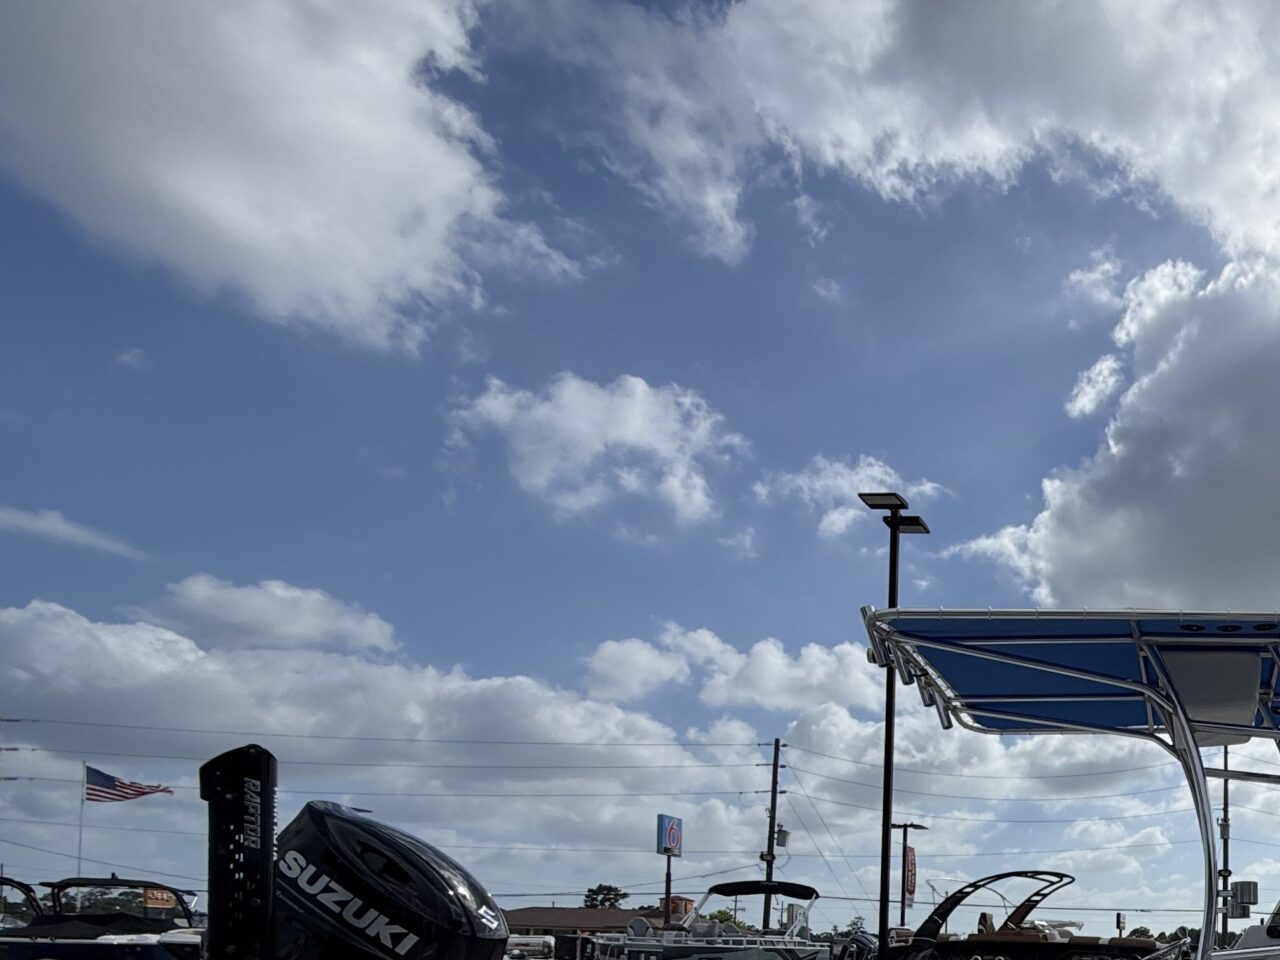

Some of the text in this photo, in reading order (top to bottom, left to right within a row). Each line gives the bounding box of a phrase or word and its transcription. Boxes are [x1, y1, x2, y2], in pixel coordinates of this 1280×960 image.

[243, 777, 261, 849] RAPTOR
[667, 817, 681, 848] 6
[279, 850, 420, 956] SUZUKI
